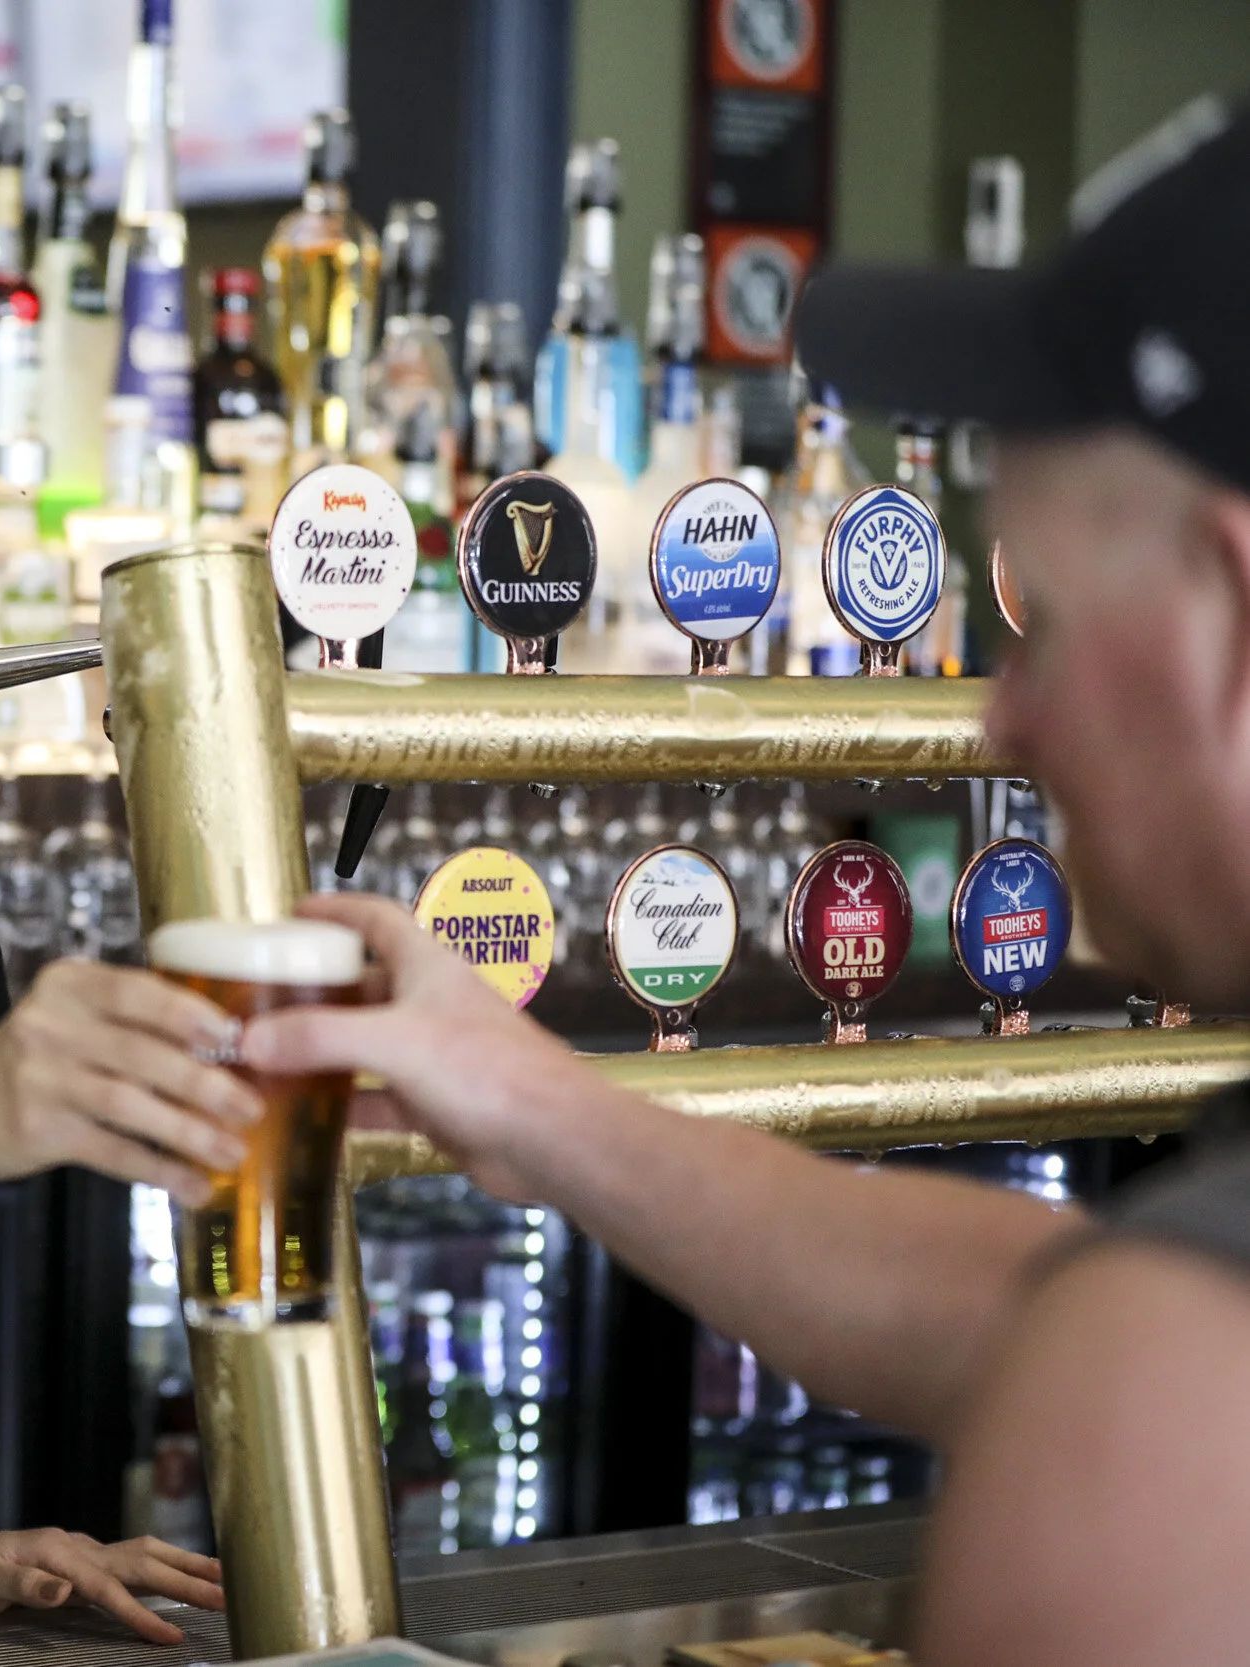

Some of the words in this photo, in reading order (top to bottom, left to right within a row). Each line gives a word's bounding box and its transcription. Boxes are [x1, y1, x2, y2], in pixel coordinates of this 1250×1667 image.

[295, 519, 393, 556] Espresso
[682, 514, 758, 545] HAHN
[854, 516, 924, 555] FURPHY
[300, 556, 386, 585] Martini
[482, 579, 582, 604] GUINNESS
[858, 578, 905, 610] REFRESHING
[905, 578, 919, 600] ALE
[462, 878, 513, 892] ABSOLUT
[630, 888, 723, 919] Canadian
[432, 914, 540, 940] PORNSTAR
[830, 910, 879, 927] TOOHEYS
[989, 913, 1041, 936] TOOHEYS
[652, 919, 703, 950] Club
[823, 936, 885, 966] OLD
[983, 940, 1048, 976] NEW
[644, 972, 706, 986] DRY
[824, 966, 859, 979] DARK
[860, 965, 884, 978] ALE
